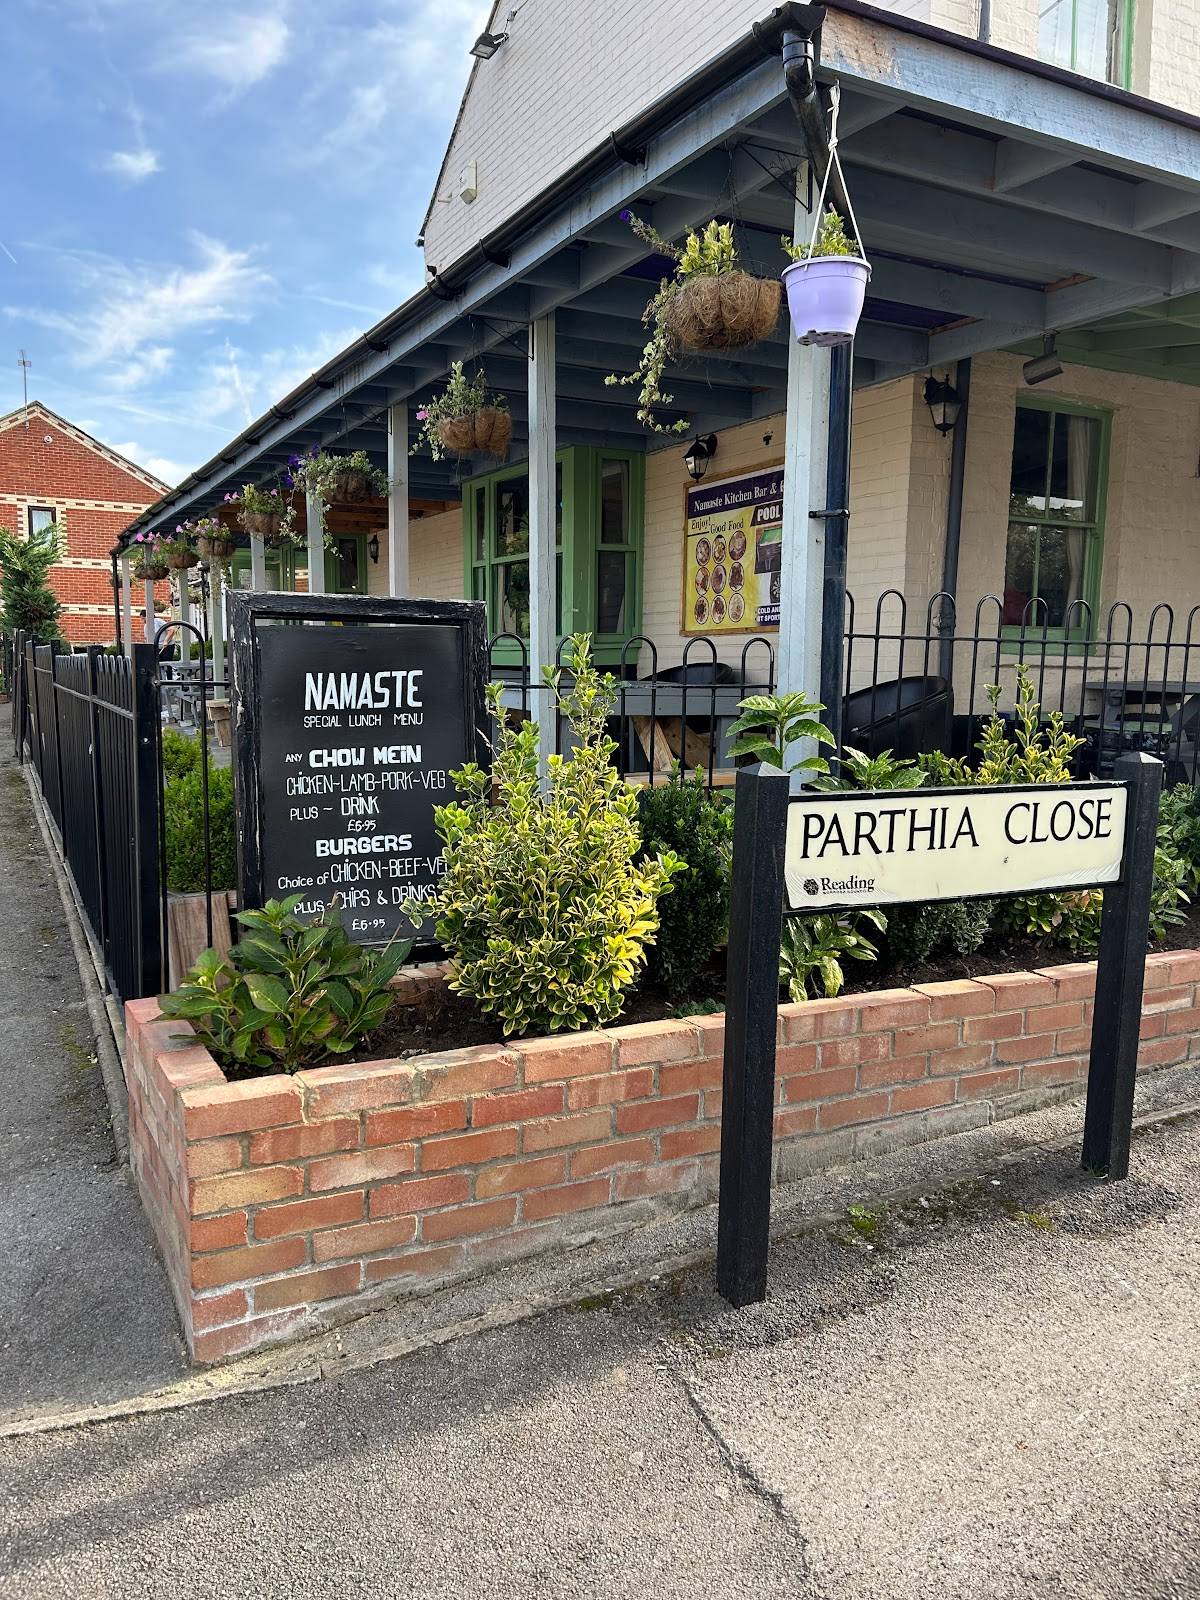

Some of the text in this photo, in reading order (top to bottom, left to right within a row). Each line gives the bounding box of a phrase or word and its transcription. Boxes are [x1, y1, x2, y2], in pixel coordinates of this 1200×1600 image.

[694, 497, 723, 512] Namaste
[724, 490, 752, 505] Kitchen
[754, 486, 768, 498] Bar
[770, 482, 777, 494] &
[757, 505, 780, 521] POOL
[710, 518, 744, 534] Good Food
[304, 669, 424, 711] NAMASTE
[303, 712, 423, 729] SPECIAL LUNCH MENU
[285, 753, 302, 763] ANY
[308, 748, 366, 768] CHOW
[290, 806, 319, 821] PLUS
[800, 797, 1113, 859] PARTHIA CLOSE
[315, 833, 413, 857] BURGERS
[278, 874, 314, 890] Choice
[317, 871, 329, 885] of
[819, 875, 876, 893] Reading
[293, 900, 325, 915] PLUS
[377, 889, 388, 905] &
